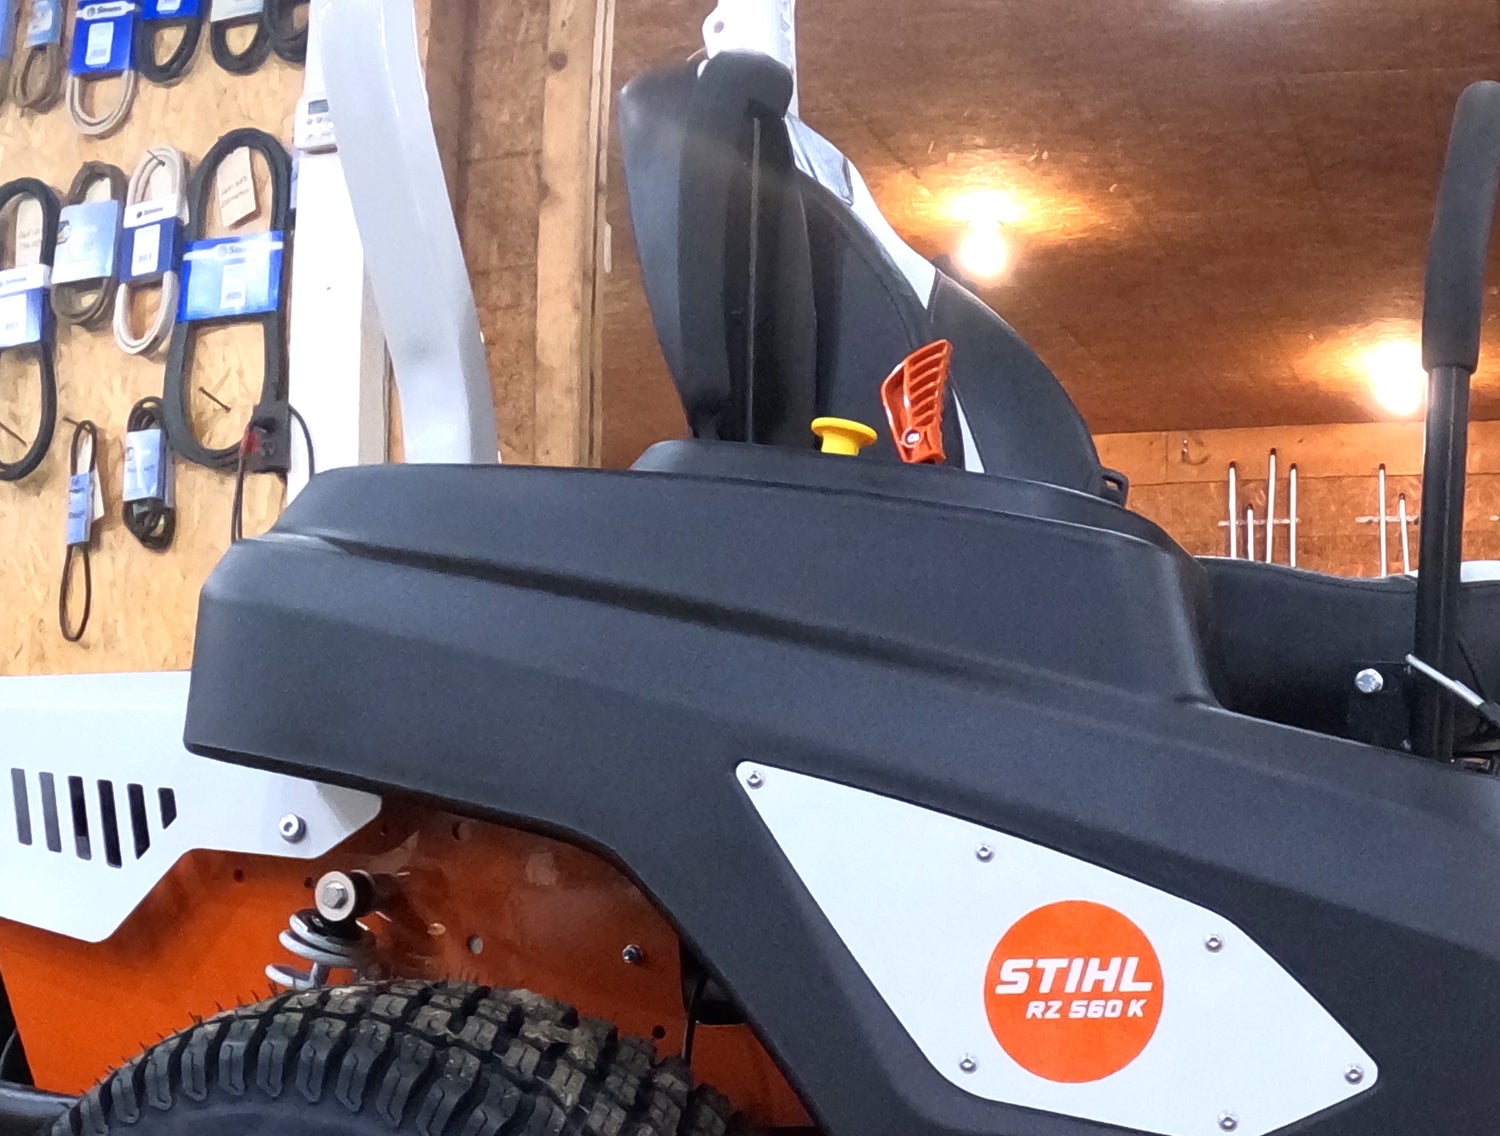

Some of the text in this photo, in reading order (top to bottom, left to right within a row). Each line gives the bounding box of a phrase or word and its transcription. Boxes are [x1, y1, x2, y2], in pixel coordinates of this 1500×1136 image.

[995, 956, 1153, 995] STIHL
[1025, 999, 1148, 1019] RZ 560 K
